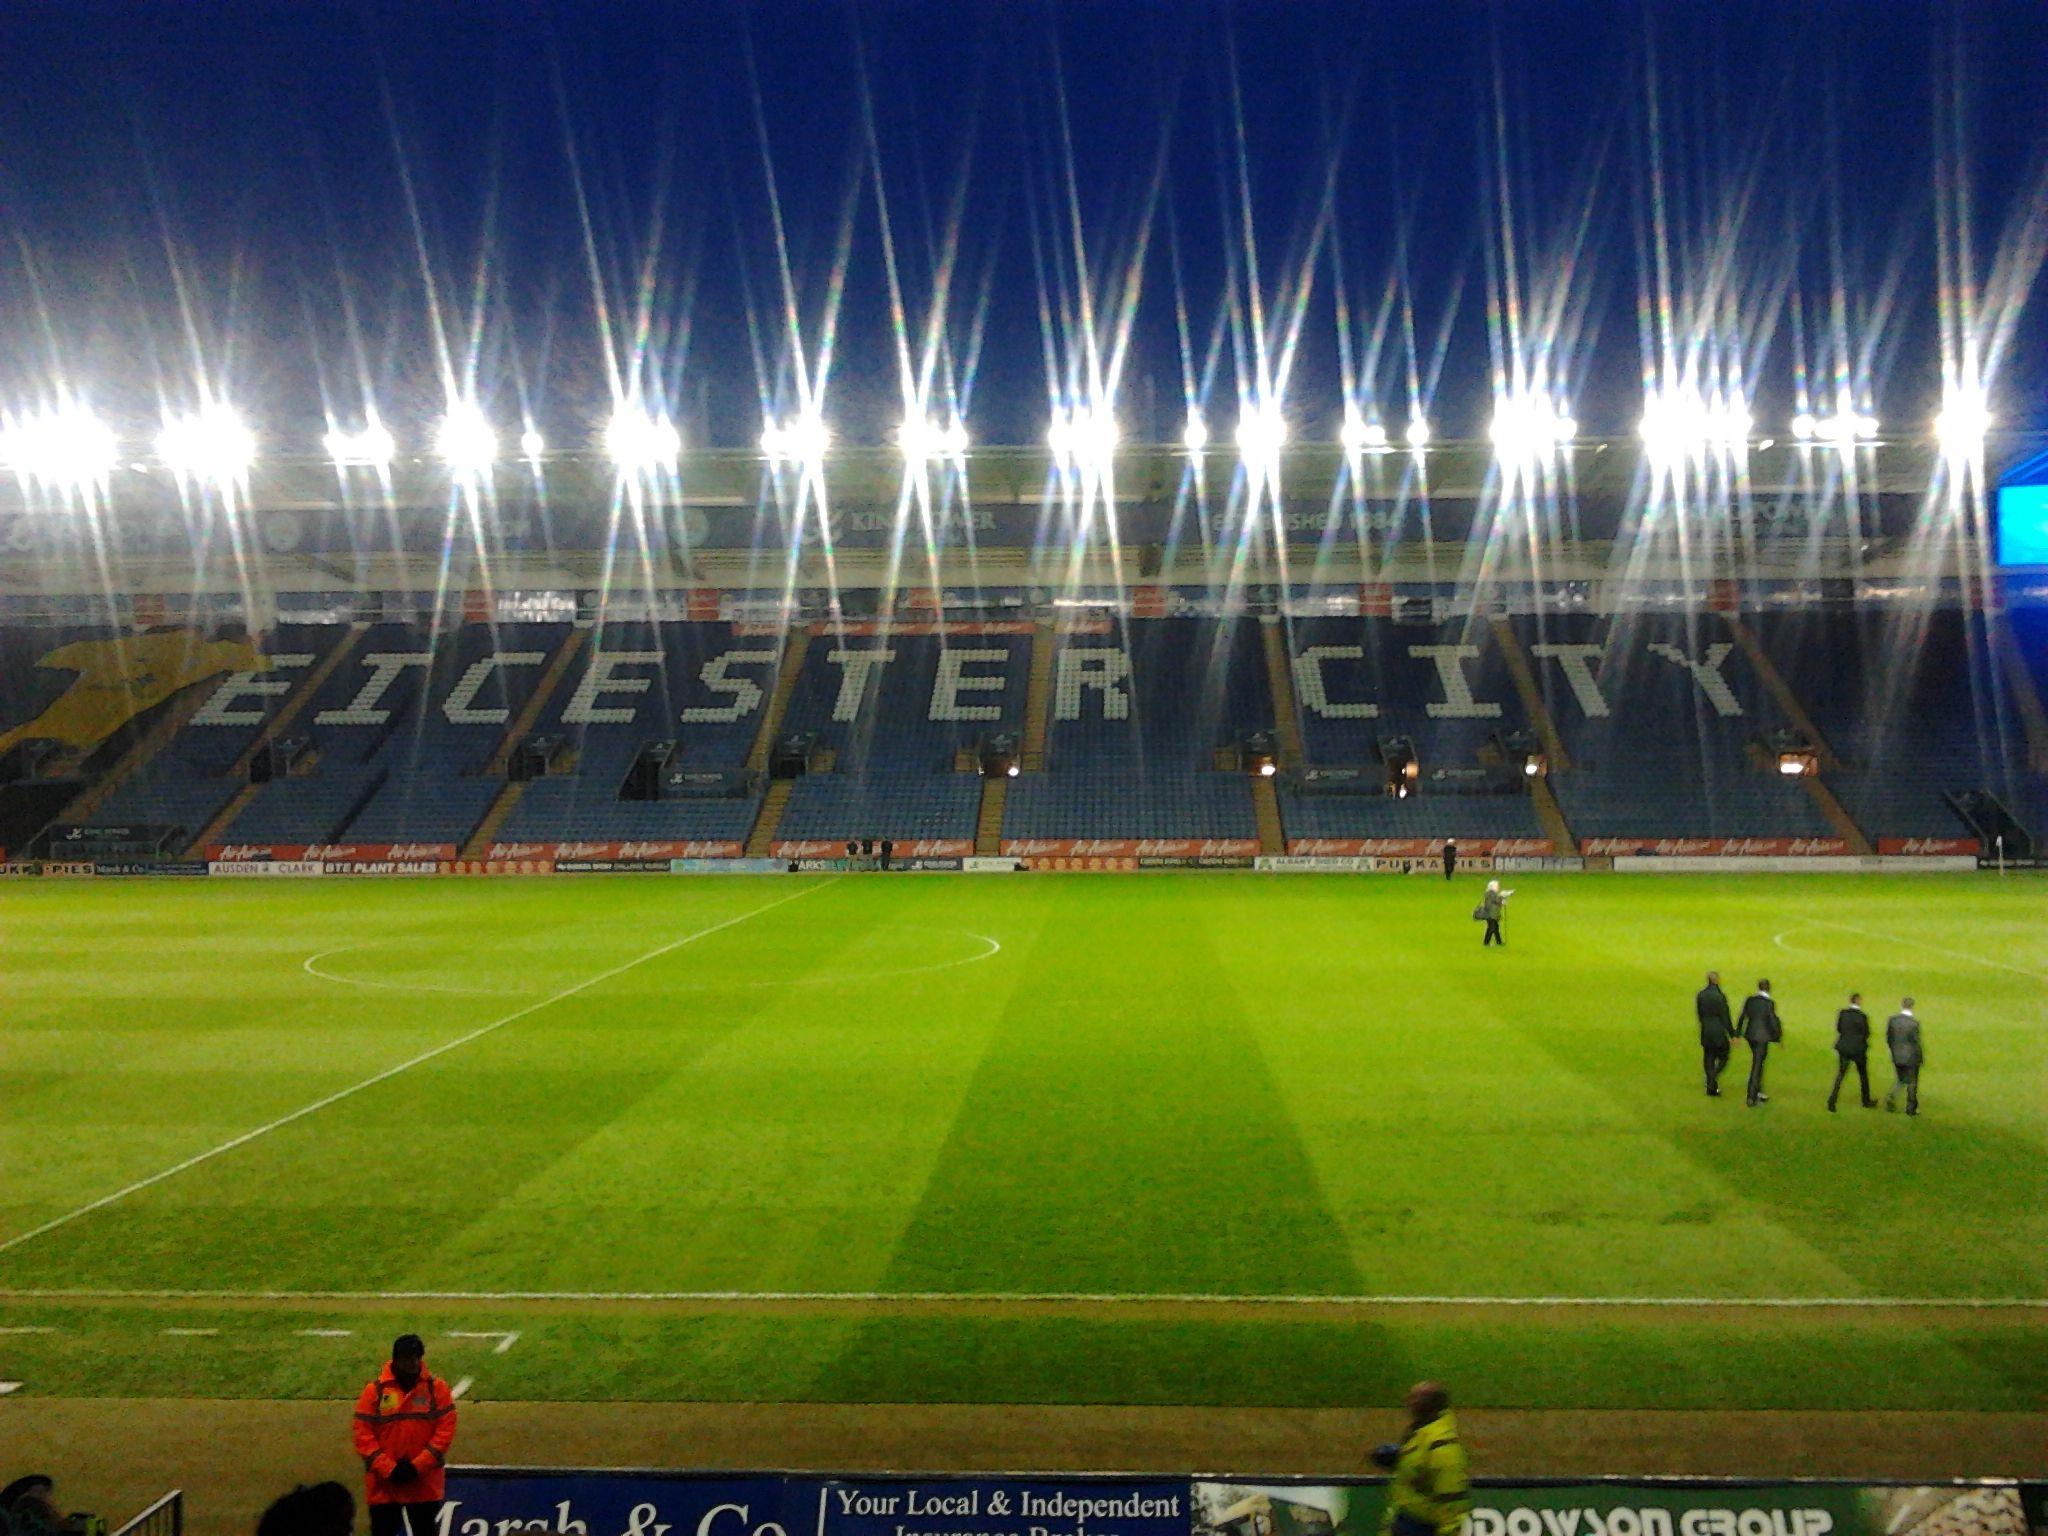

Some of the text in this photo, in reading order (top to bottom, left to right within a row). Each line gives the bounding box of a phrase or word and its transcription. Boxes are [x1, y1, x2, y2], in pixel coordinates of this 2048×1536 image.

[186, 642, 1744, 726] EICESTER CITY
[214, 863, 258, 873] AUSDEN
[278, 863, 314, 873] CLARK
[354, 862, 396, 873] PLANT
[397, 862, 437, 873] SALES
[622, 1503, 672, 1536] &
[838, 1490, 1181, 1523] Your Local & Independent
[1461, 1507, 1833, 1536] DOWSON GROUP
